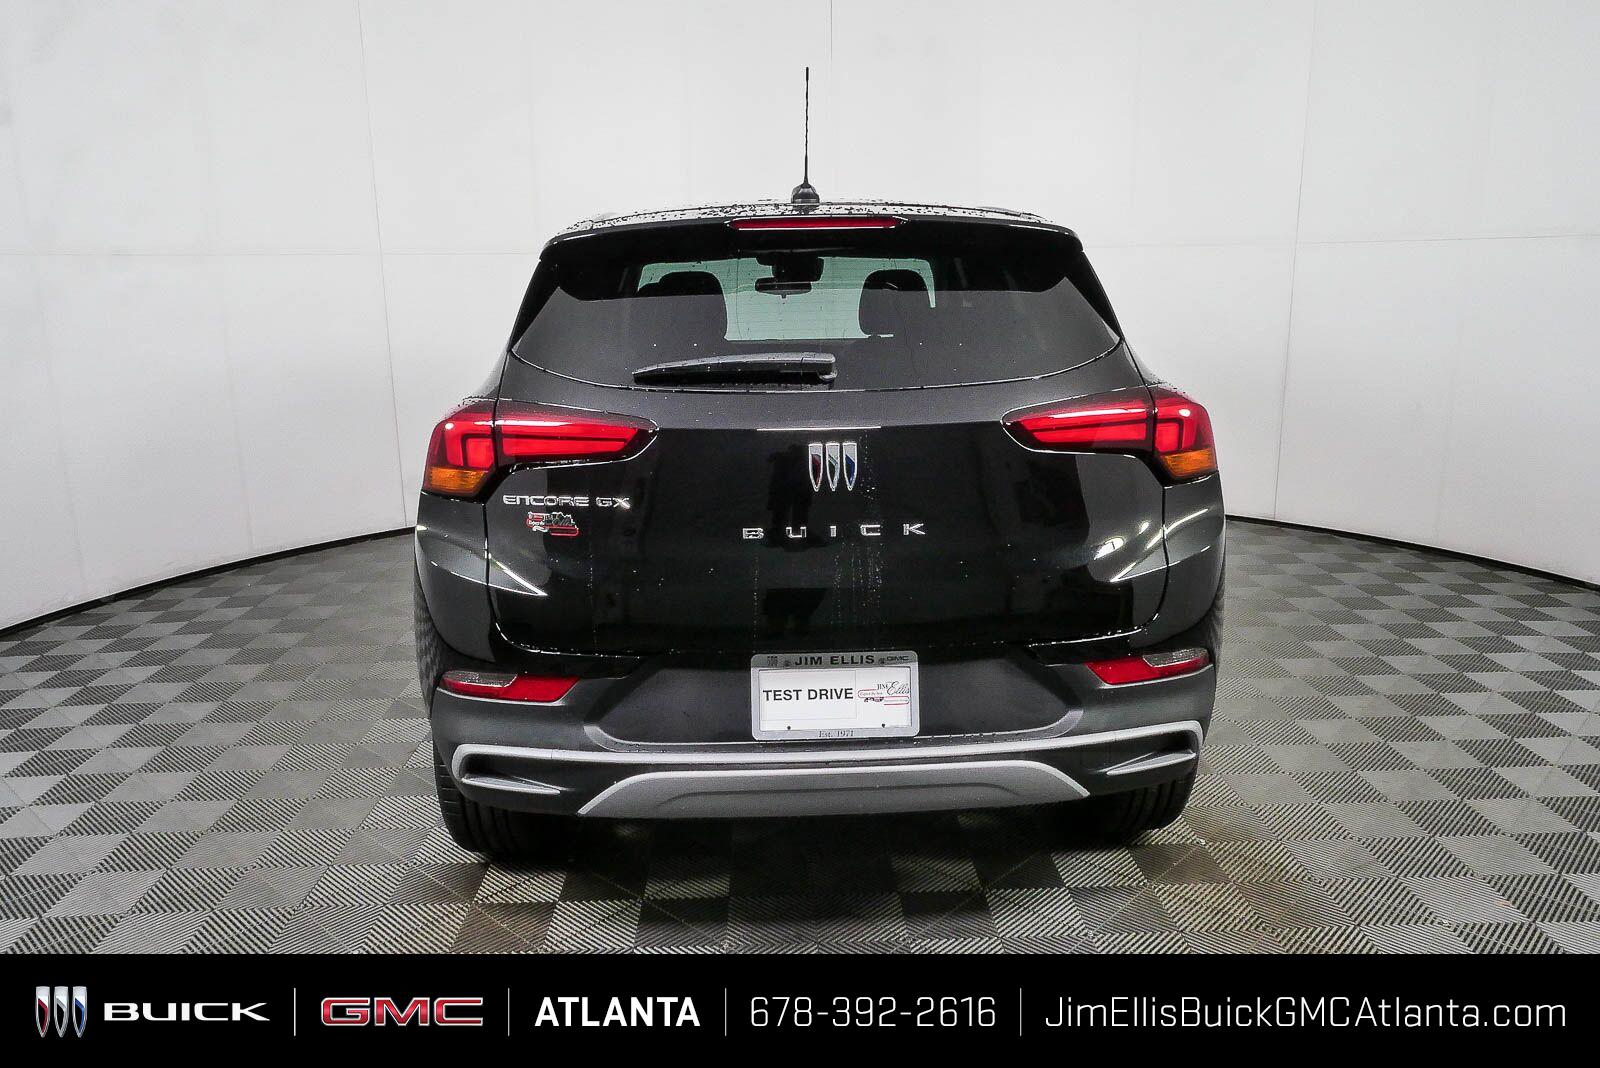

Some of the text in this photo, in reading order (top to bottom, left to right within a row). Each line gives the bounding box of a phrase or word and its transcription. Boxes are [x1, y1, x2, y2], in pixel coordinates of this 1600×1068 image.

[503, 495, 631, 509] ENCORE GX
[742, 523, 926, 540] BUICK
[794, 655, 875, 666] JIM ELLIS
[763, 689, 802, 702] TEST
[808, 688, 854, 701] DRIVE
[886, 681, 910, 696] Ellis
